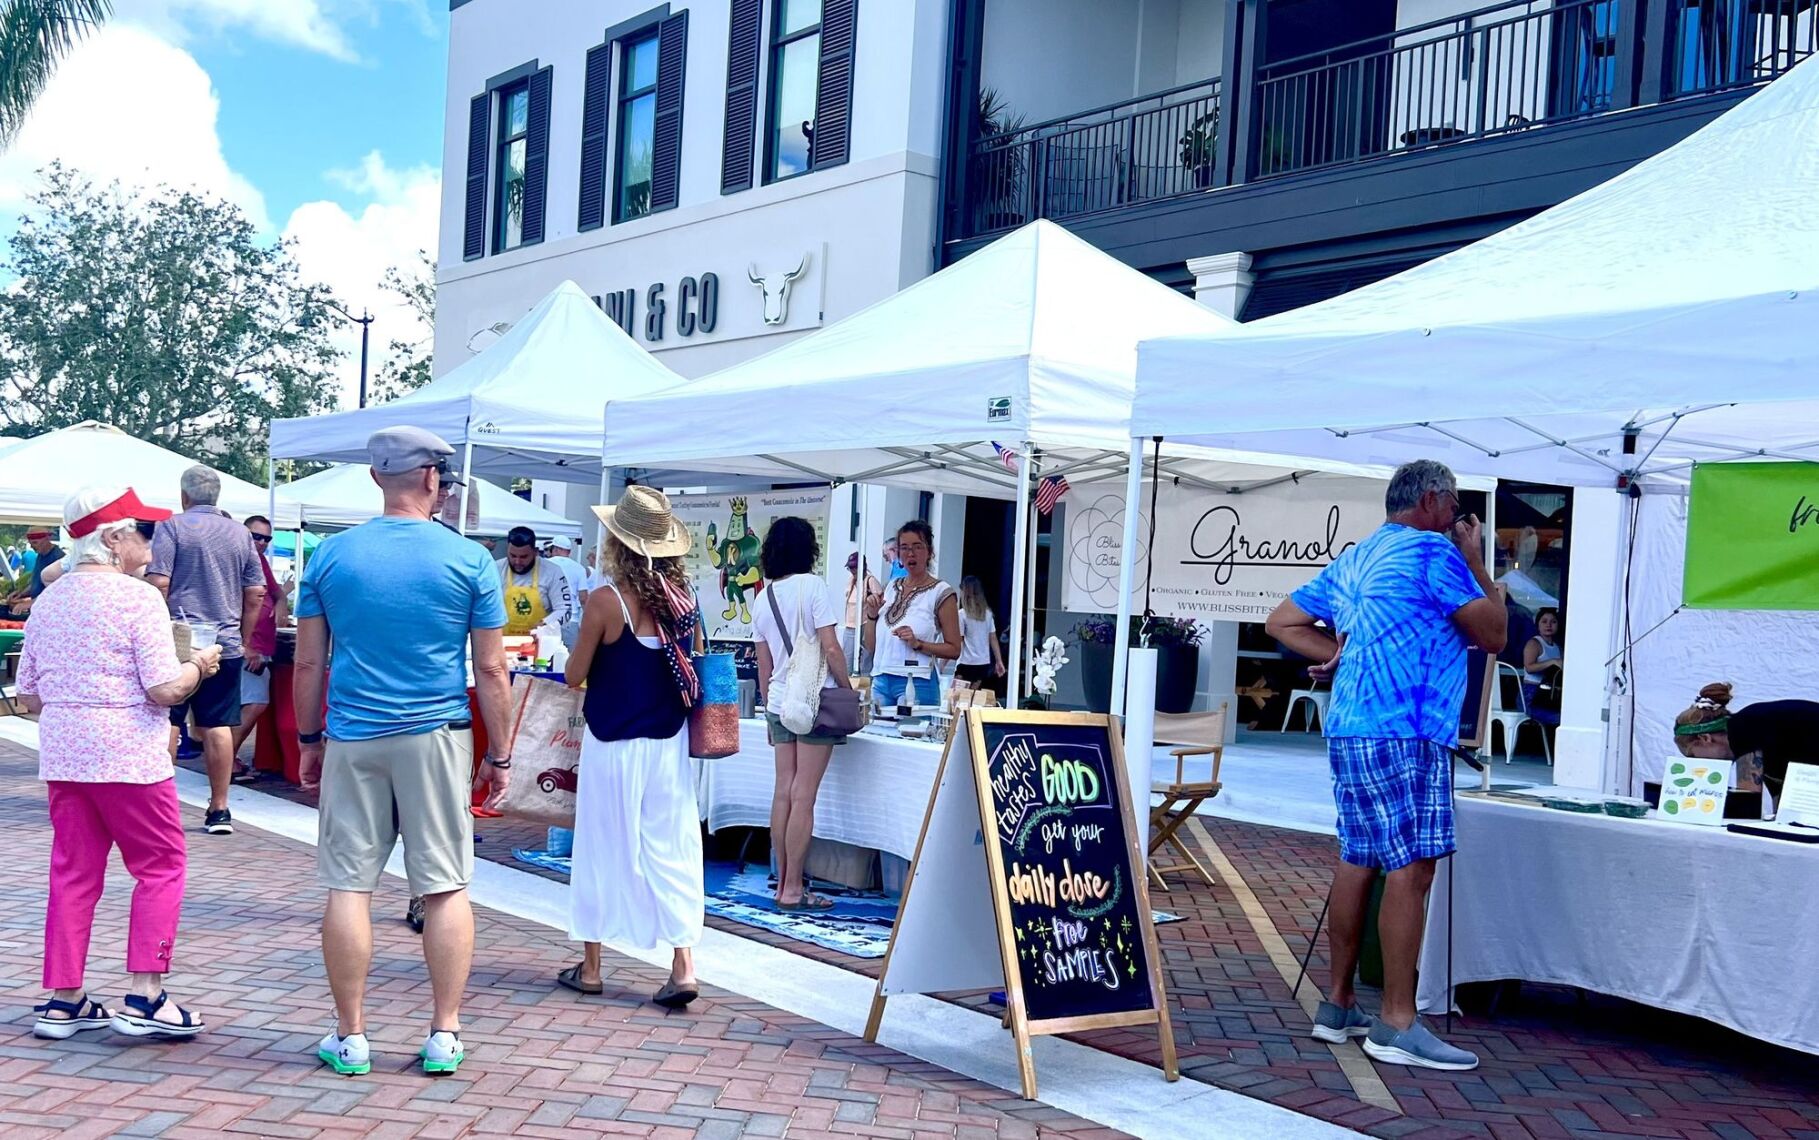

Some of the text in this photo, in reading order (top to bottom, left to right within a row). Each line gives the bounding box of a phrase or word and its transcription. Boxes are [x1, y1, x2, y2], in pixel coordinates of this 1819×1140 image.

[645, 282, 666, 342] &
[677, 271, 719, 337] CO
[1177, 602, 1276, 615] WWW.BLISSBITES
[1265, 590, 1290, 599] VEGA
[991, 738, 1037, 803] healthy
[1041, 753, 1100, 805] GOOD
[996, 771, 1037, 835] tastes
[1042, 819, 1105, 854] get your
[1008, 858, 1110, 908] daily dose
[1043, 947, 1121, 991] SAMPLES
